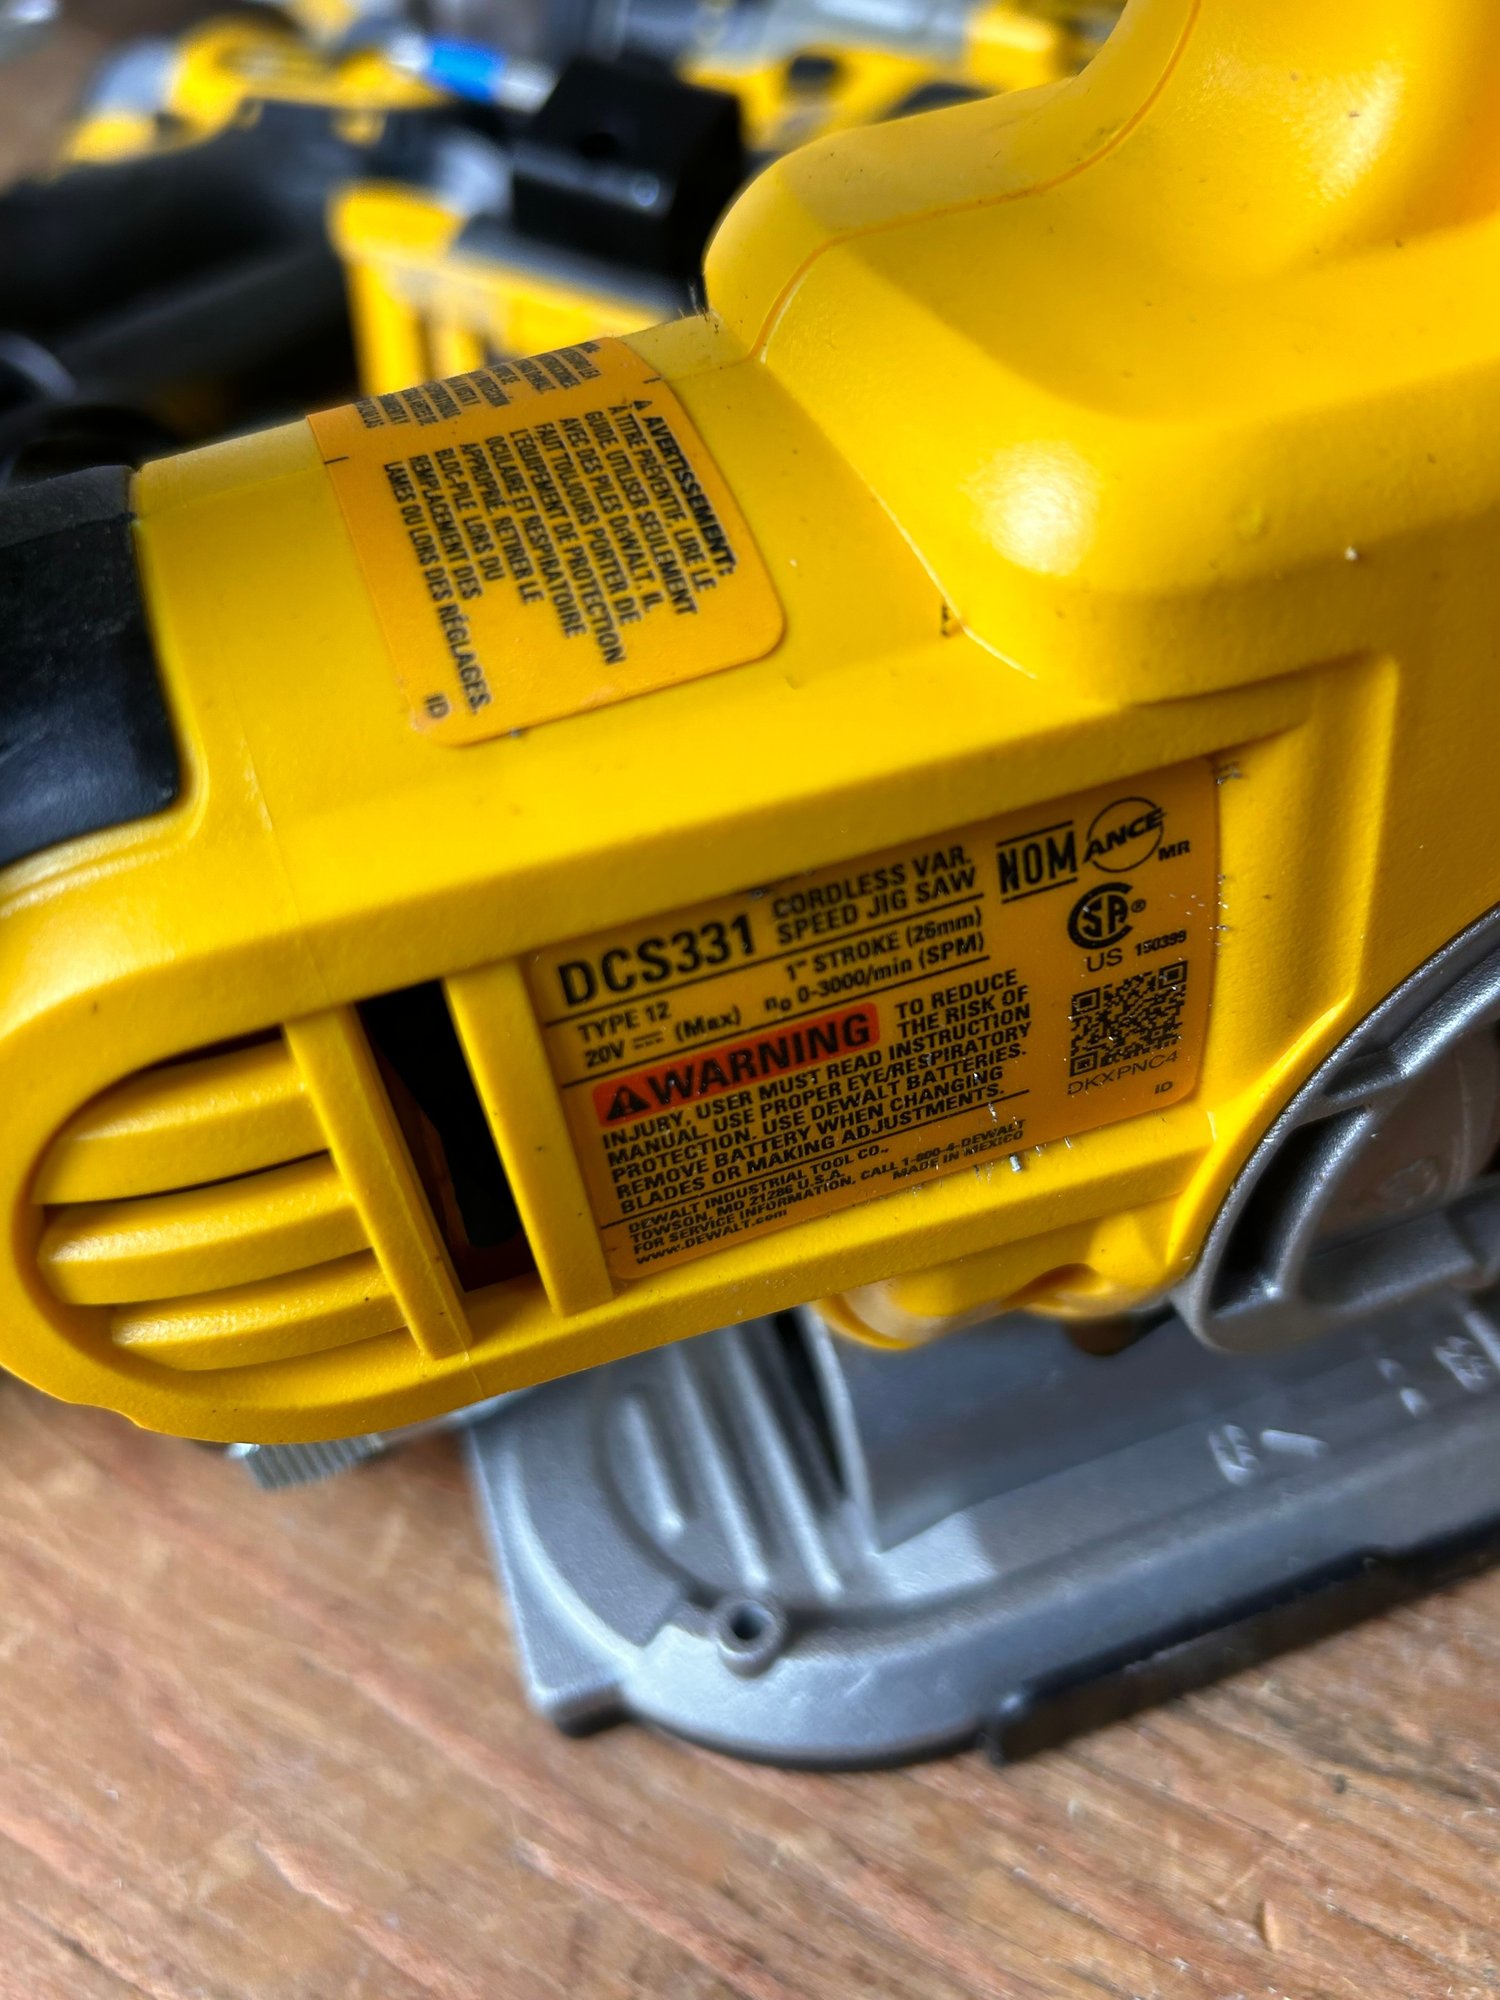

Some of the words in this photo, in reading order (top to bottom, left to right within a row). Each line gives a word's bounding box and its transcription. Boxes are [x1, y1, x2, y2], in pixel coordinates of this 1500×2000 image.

[558, 418, 591, 448] AVEC
[614, 413, 648, 449] TITRE
[383, 461, 416, 503] LAMES
[484, 435, 528, 496] OCULAIRE
[575, 447, 604, 475] DES
[400, 504, 425, 526] OU
[434, 447, 477, 512] BLOC-PILE
[461, 515, 494, 554] LORS
[478, 556, 504, 581] DU
[511, 495, 536, 513] ET
[534, 422, 566, 452] FAUT
[550, 451, 599, 526] TOUJOURS
[583, 527, 628, 595] PORTER
[612, 596, 640, 625] DE
[588, 474, 623, 514] PILES
[642, 416, 735, 575] AVERTISSEMENT:
[408, 454, 468, 562] REMPLACEMENT
[451, 565, 482, 600] DES
[408, 526, 440, 566] LORS
[552, 521, 578, 543] DE
[605, 449, 650, 510] UTILISER
[635, 510, 697, 614] SEULEMENT
[673, 528, 706, 567] LIRE
[423, 567, 453, 602] DES
[491, 516, 533, 580] RETIRER
[517, 581, 544, 603] LE
[520, 514, 584, 634] RESPIRATOIRE
[689, 568, 716, 592] LE
[562, 545, 625, 665] PROTECTION
[640, 591, 664, 612] IL
[424, 695, 448, 719] ID
[996, 830, 1078, 895] NOM
[1083, 806, 1166, 864] ANCE
[1158, 840, 1190, 861] MR
[772, 863, 906, 919] CORDLESS
[911, 844, 971, 878] VAR.
[777, 903, 859, 945] SPEED
[866, 888, 908, 919] JIG
[915, 866, 976, 904] SAW
[556, 912, 755, 1008] DCS331
[797, 956, 913, 1004] 0-3000/min
[918, 931, 984, 970] (SPM)
[813, 931, 901, 973] STROKE
[905, 905, 982, 948] (26mm)
[1086, 947, 1122, 973] US
[1135, 930, 1187, 957] 150399
[576, 1010, 639, 1043] TYPE
[645, 1001, 671, 1023] 12
[894, 998, 924, 1020] TO
[931, 968, 1018, 1010] REDUCE
[897, 1011, 940, 1039] THE
[945, 994, 996, 1025] RISK
[1001, 984, 1028, 1007] OF
[584, 1040, 625, 1070] 20V
[674, 1005, 741, 1043] (Max)
[647, 1013, 870, 1106] WARNING
[601, 1110, 691, 1151] INJURY,
[695, 1090, 754, 1120] USER
[758, 1067, 821, 1101] MUST
[826, 1049, 882, 1081] READ
[888, 1003, 1031, 1061] INSTRUCTION
[605, 1125, 709, 1168] MANUAL.
[713, 1107, 755, 1133] USE
[760, 1081, 842, 1120] PROPER
[847, 1021, 1032, 1092] EYE/RESPIRATORY
[1067, 1050, 1178, 1096] DKXPNC4
[1154, 1080, 1173, 1095] ID
[610, 1127, 757, 1184] PROTECTION.
[762, 1110, 806, 1135] USE
[810, 1079, 901, 1121] DEWALT
[906, 1042, 1027, 1091] BATTERIES.
[615, 1158, 709, 1200] REMOVE
[714, 1125, 811, 1169] BATTERY
[815, 1102, 884, 1135] WHEN
[889, 1065, 1003, 1113] CHANGING
[620, 1176, 706, 1215] BLADES
[712, 1165, 742, 1185] OR
[746, 1135, 835, 1175] MAKING
[841, 1082, 1005, 1145] ADJUSTMENTS.
[892, 1157, 939, 1181] MADE
[942, 1150, 960, 1164] IN
[963, 1130, 1024, 1157] MEXICO
[627, 1201, 700, 1234] DEWALT
[704, 1169, 808, 1210] INDUSTRIAL
[809, 1154, 855, 1175] TOOL
[629, 1211, 714, 1244] TOWSON,
[716, 1200, 745, 1217] MD
[749, 1184, 794, 1207] 21286
[797, 1168, 846, 1190] U.S.A.
[633, 1236, 665, 1255] FOR
[668, 1213, 735, 1243] SERVICE
[739, 1175, 857, 1220] INFORMATION,
[860, 1161, 899, 1181] CALL
[901, 1119, 1026, 1167] 1-800-4-DEWALT
[635, 1209, 788, 1265] www.DEWALT.com
